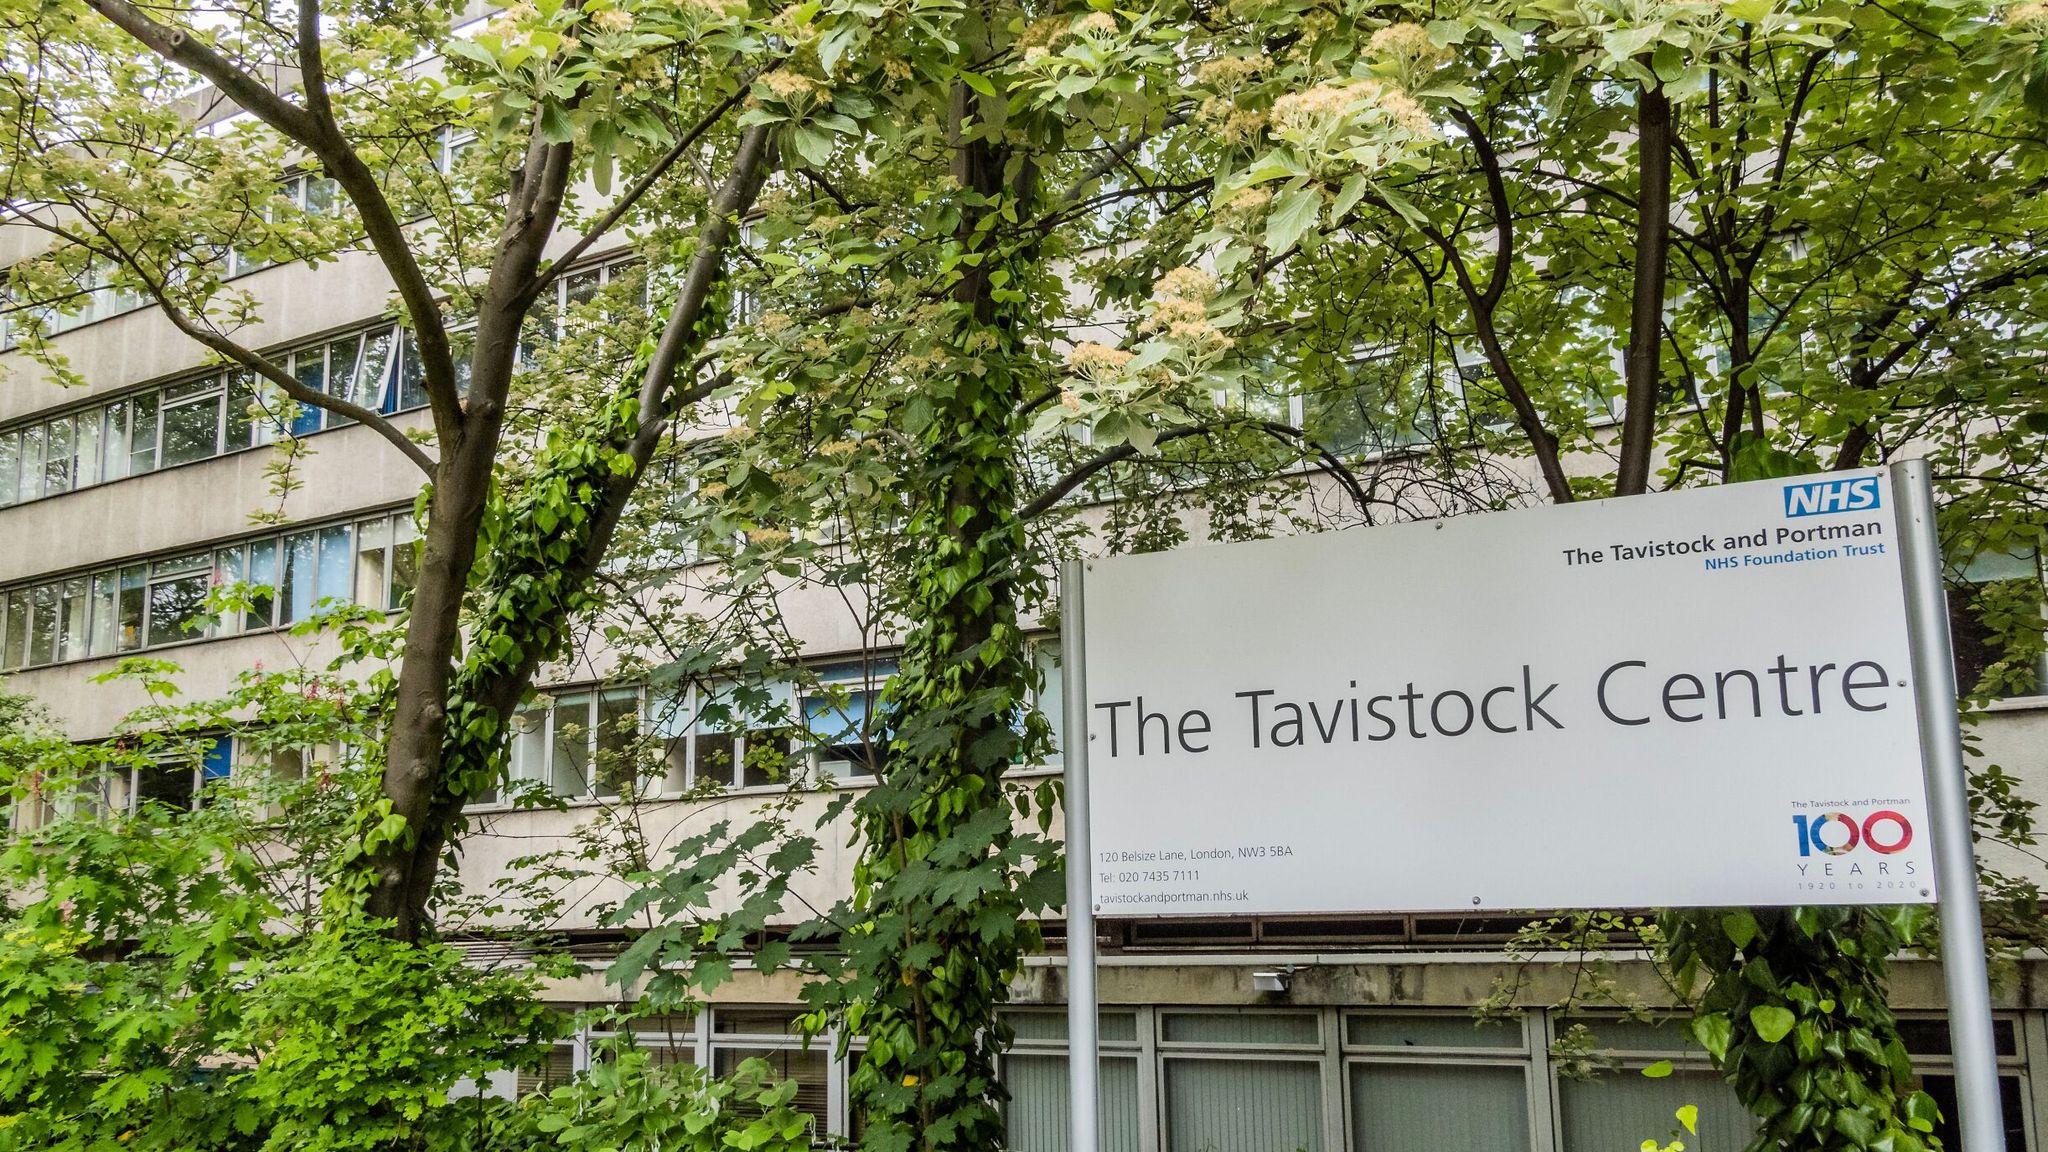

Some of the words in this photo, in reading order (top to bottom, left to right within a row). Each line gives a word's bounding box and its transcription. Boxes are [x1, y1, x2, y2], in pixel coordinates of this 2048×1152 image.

[1788, 478, 1876, 516] NHS
[1563, 549, 1603, 566] The
[1610, 535, 1716, 561] Tavistock
[1724, 529, 1768, 551] and
[1776, 522, 1882, 545] Portman
[1705, 556, 1739, 570] NHS
[1744, 547, 1838, 567] Foundation
[1843, 542, 1886, 557] Trust
[1095, 696, 1211, 758] The
[1235, 664, 1565, 749] Tavistock
[1596, 652, 1890, 727] Centre
[1791, 801, 1807, 809] The
[1810, 799, 1849, 808] Tavistock
[1852, 798, 1869, 806] and
[1871, 797, 1911, 806] Portman
[1792, 810, 1913, 857] 100
[1100, 852, 1118, 862] 120
[1121, 850, 1156, 862] Belsize
[1159, 849, 1187, 861] Lane,
[1190, 848, 1234, 860] London,
[1238, 846, 1266, 858] NW3
[1269, 845, 1293, 857] 5BA
[1100, 872, 1115, 884] Tel:
[1118, 872, 1139, 882] 020
[1142, 870, 1169, 882] 7435
[1173, 870, 1200, 881] 7111
[1797, 861, 1915, 877] YEARS
[1798, 881, 1836, 890] 1920
[1849, 881, 1864, 889] to
[1877, 880, 1916, 889] 2020
[1100, 889, 1248, 904] tavistockandportman.nhs.uk
